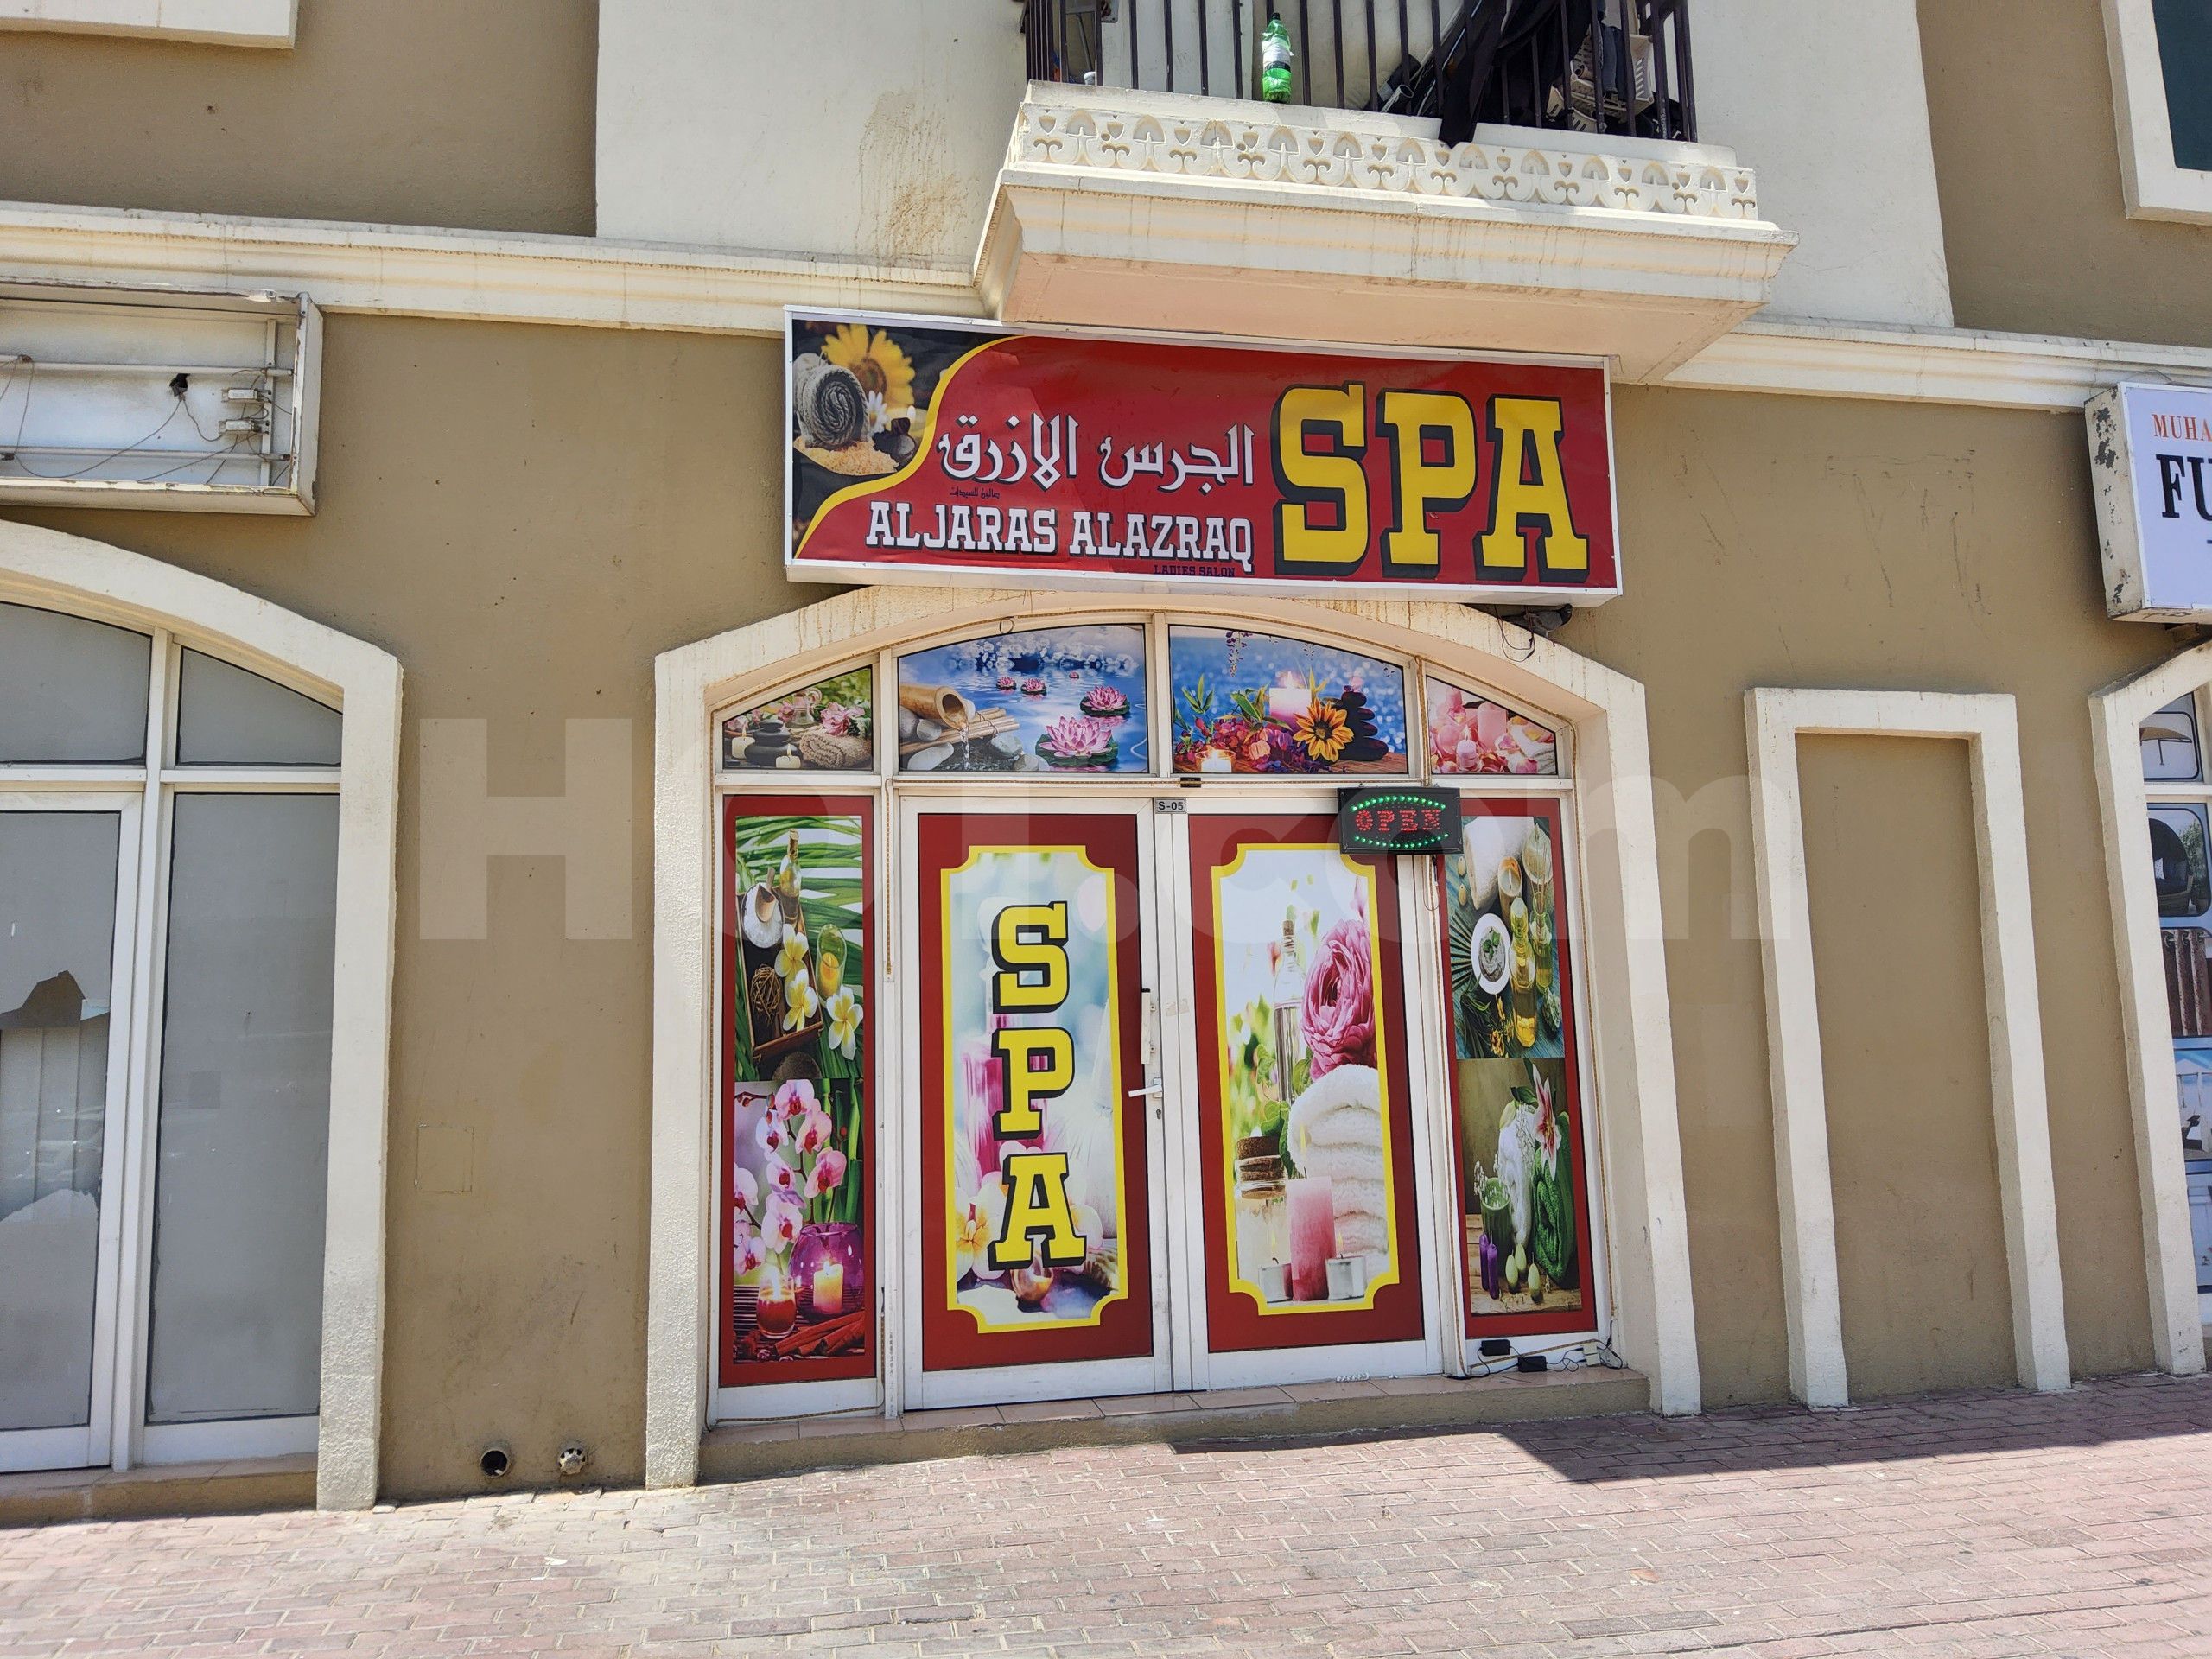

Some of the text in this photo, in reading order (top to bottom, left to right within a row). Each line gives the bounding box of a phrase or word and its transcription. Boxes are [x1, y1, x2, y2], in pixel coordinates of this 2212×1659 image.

[1100, 423, 1255, 495] الجرس
[1272, 381, 1589, 581] SPA
[866, 500, 1254, 574] ALJARAS ALAZRAQ
[1154, 565, 1236, 577] LADIES SALON
[1158, 801, 1184, 810] S-05
[1355, 809, 1441, 832] OPEN
[988, 900, 1086, 1271] SPA
